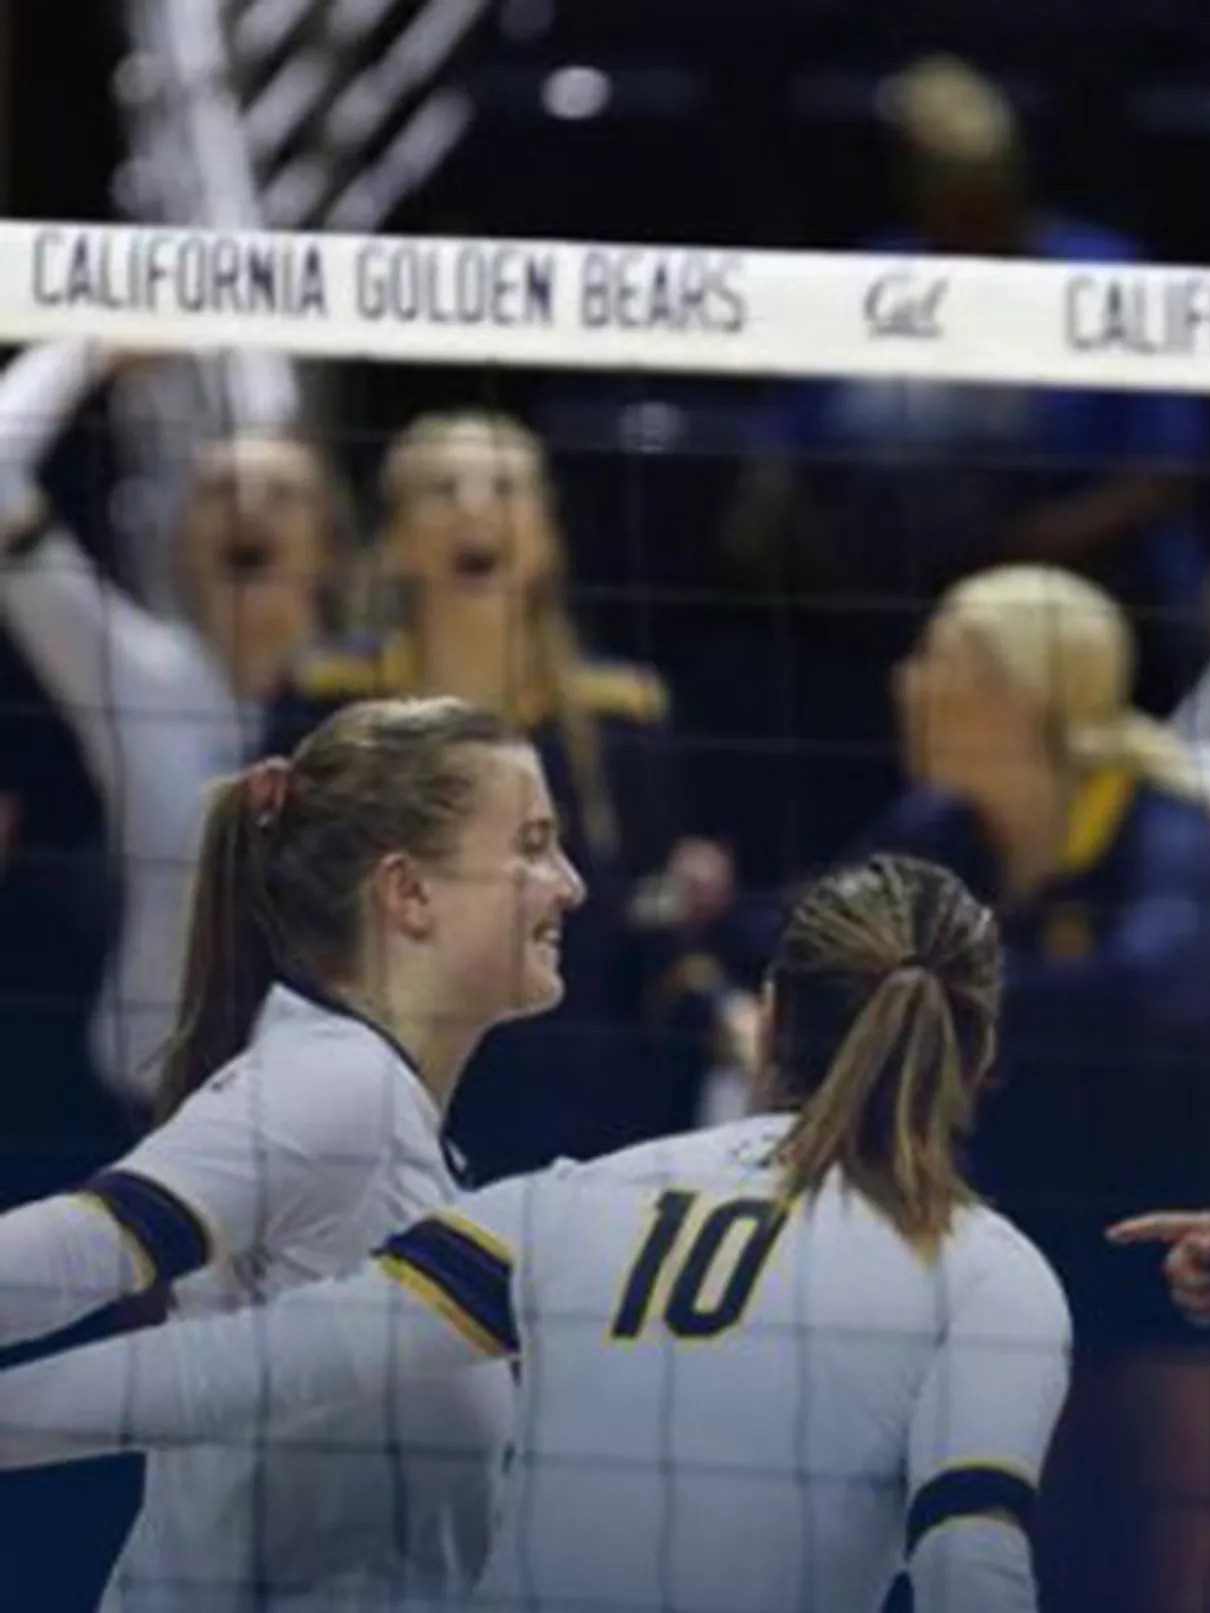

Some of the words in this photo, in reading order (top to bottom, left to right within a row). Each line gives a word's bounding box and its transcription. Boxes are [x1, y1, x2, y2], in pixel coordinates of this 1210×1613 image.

[31, 226, 328, 320] CALIFORNIA
[354, 243, 555, 327] GOLDEN
[578, 249, 748, 335] BEARS
[862, 273, 949, 340] Cal
[608, 1186, 792, 1344] 10
